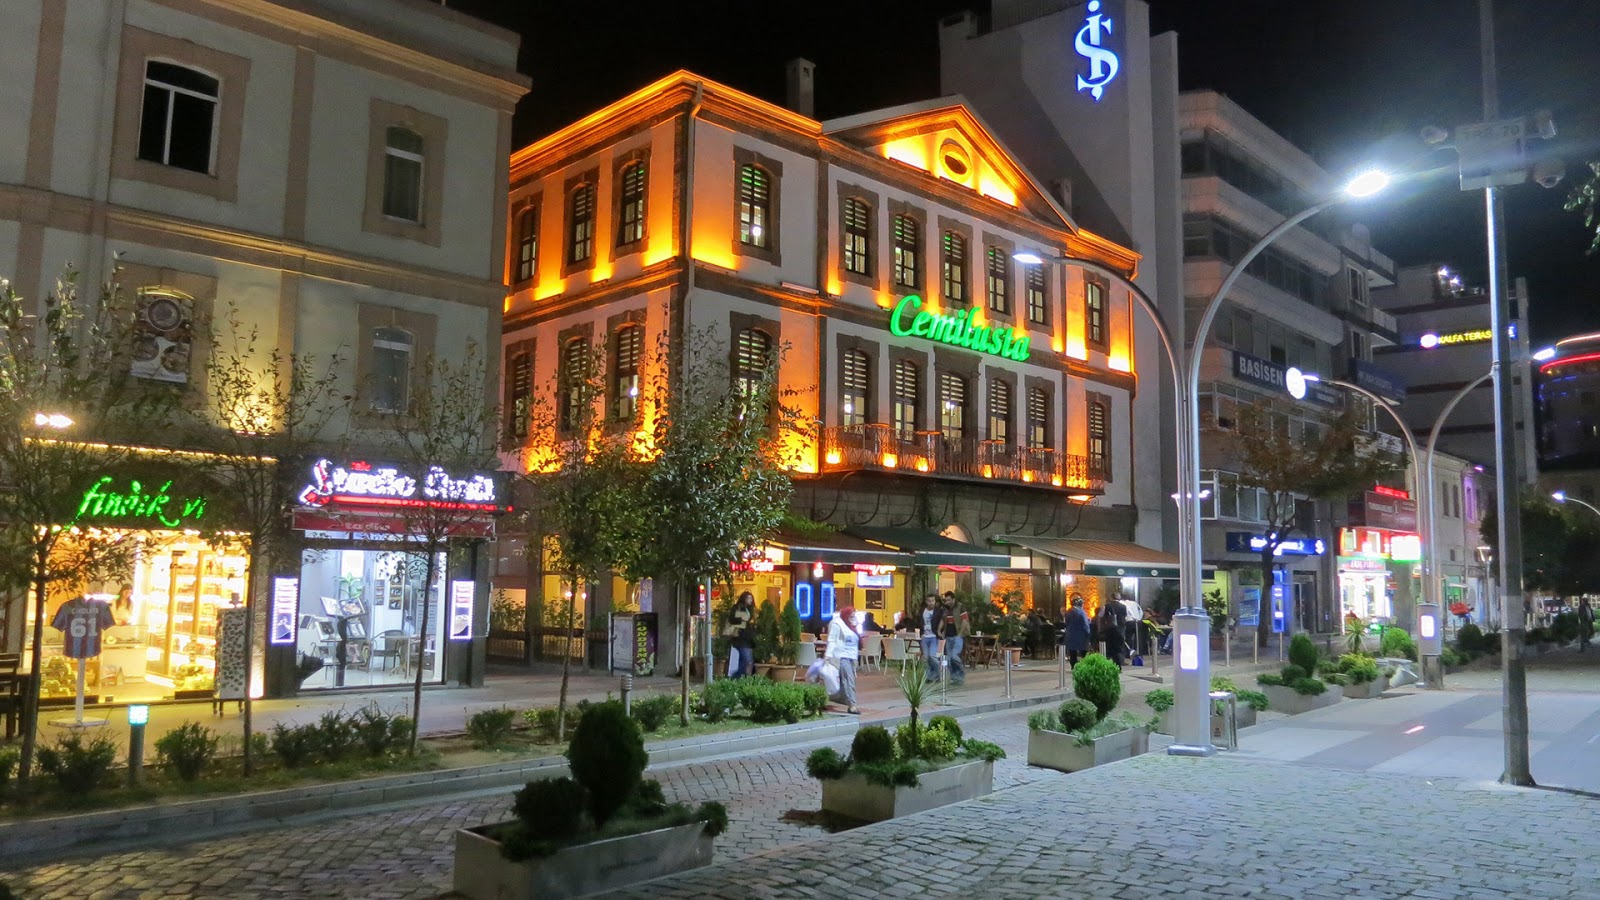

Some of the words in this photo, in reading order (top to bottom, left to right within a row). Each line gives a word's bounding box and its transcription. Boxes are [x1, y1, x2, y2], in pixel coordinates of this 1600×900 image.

[890, 294, 1031, 361] Cemilusta
[1438, 333, 1464, 344] KALFA
[1464, 329, 1493, 341] TERAS
[1239, 356, 1283, 386] BASİSEN
[70, 617, 97, 637] 61
